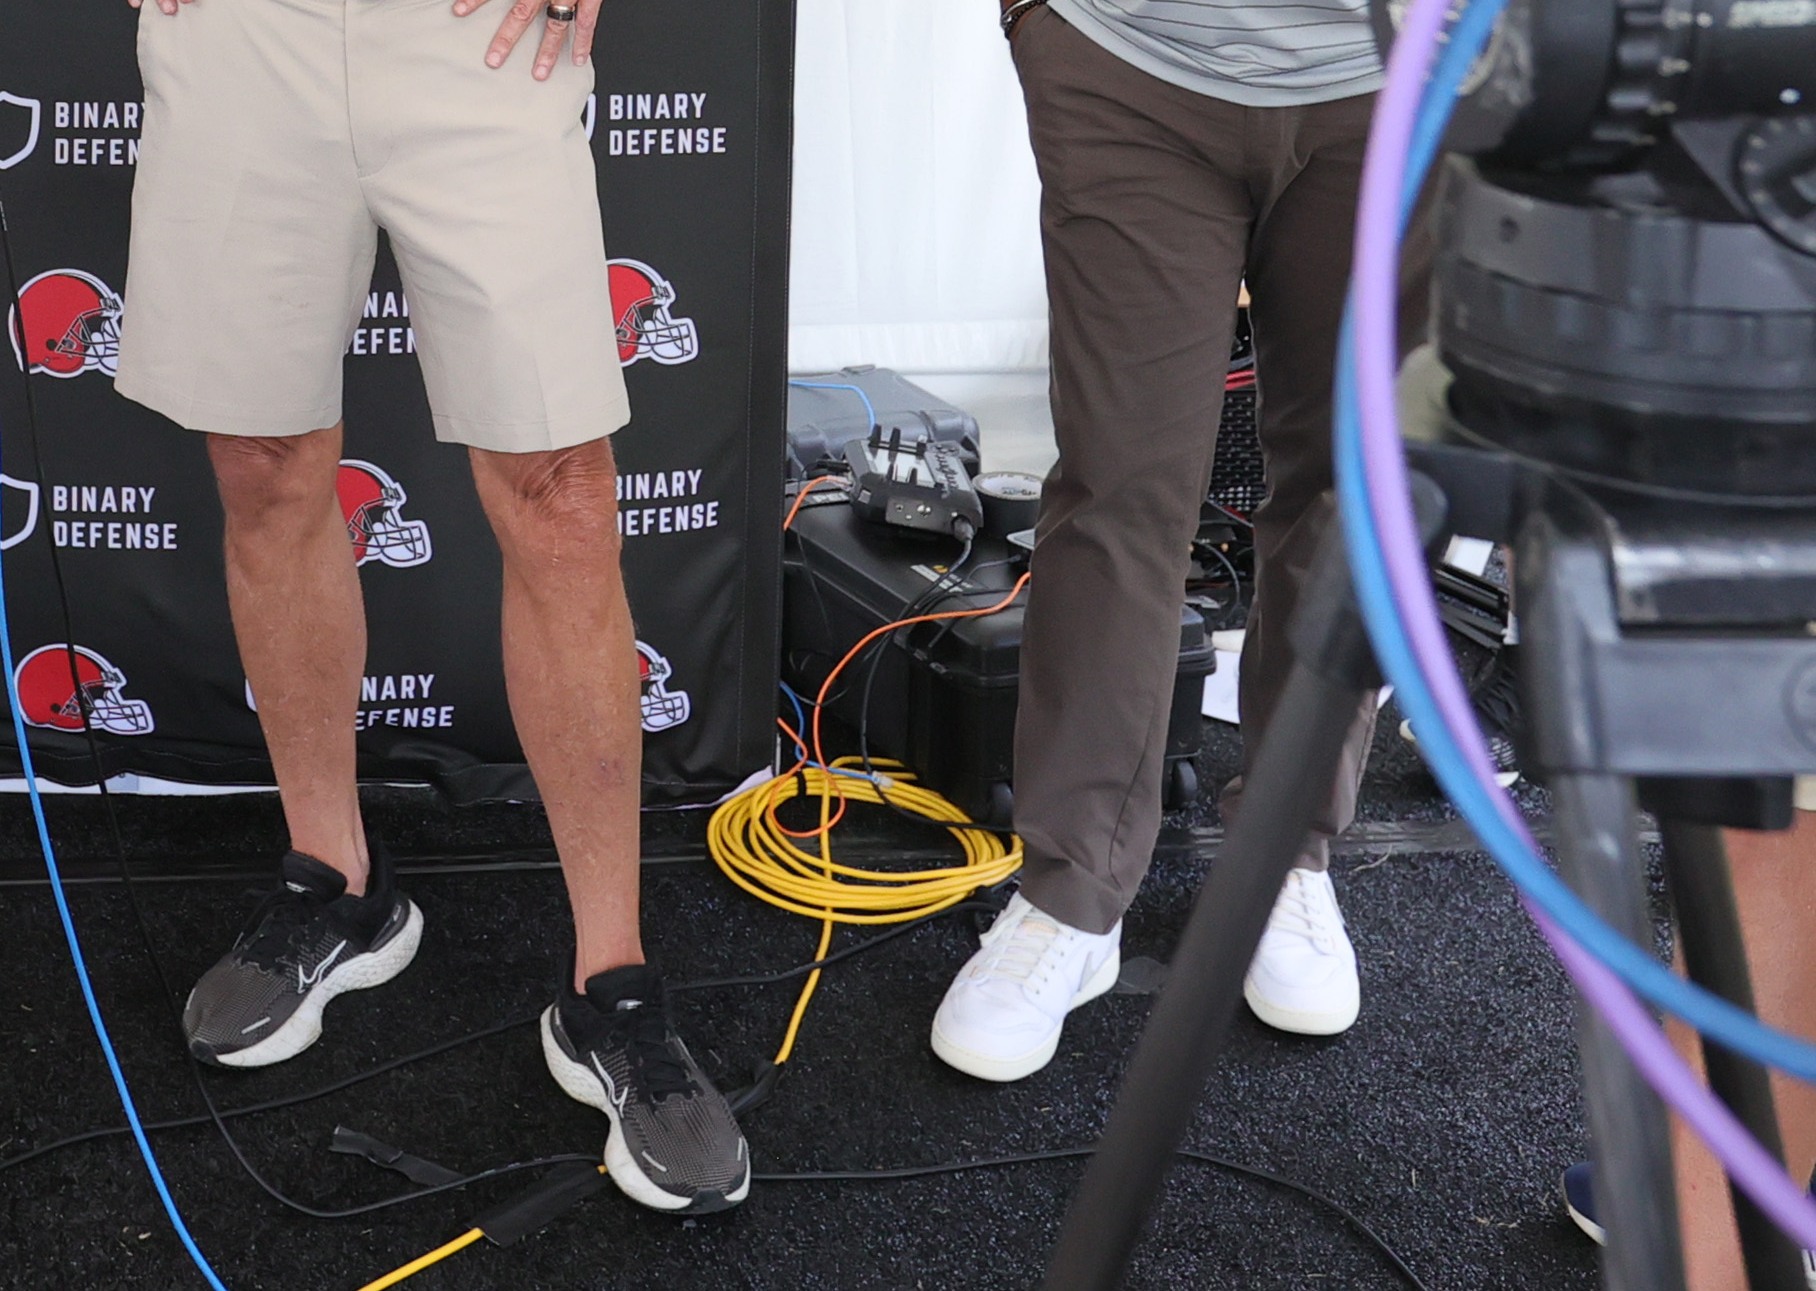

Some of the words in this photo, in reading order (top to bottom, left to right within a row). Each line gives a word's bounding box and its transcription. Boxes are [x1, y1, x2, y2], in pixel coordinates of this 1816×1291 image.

[55, 102, 146, 129] BINAR
[609, 92, 707, 120] BINARY
[55, 138, 141, 166] DEFEN
[609, 127, 727, 156] DEFENSE
[352, 327, 414, 355] EFEN
[53, 485, 155, 513] BINARY
[53, 521, 178, 549] DEFENSE
[361, 674, 435, 702] NARY
[353, 705, 455, 731] EFENSE
